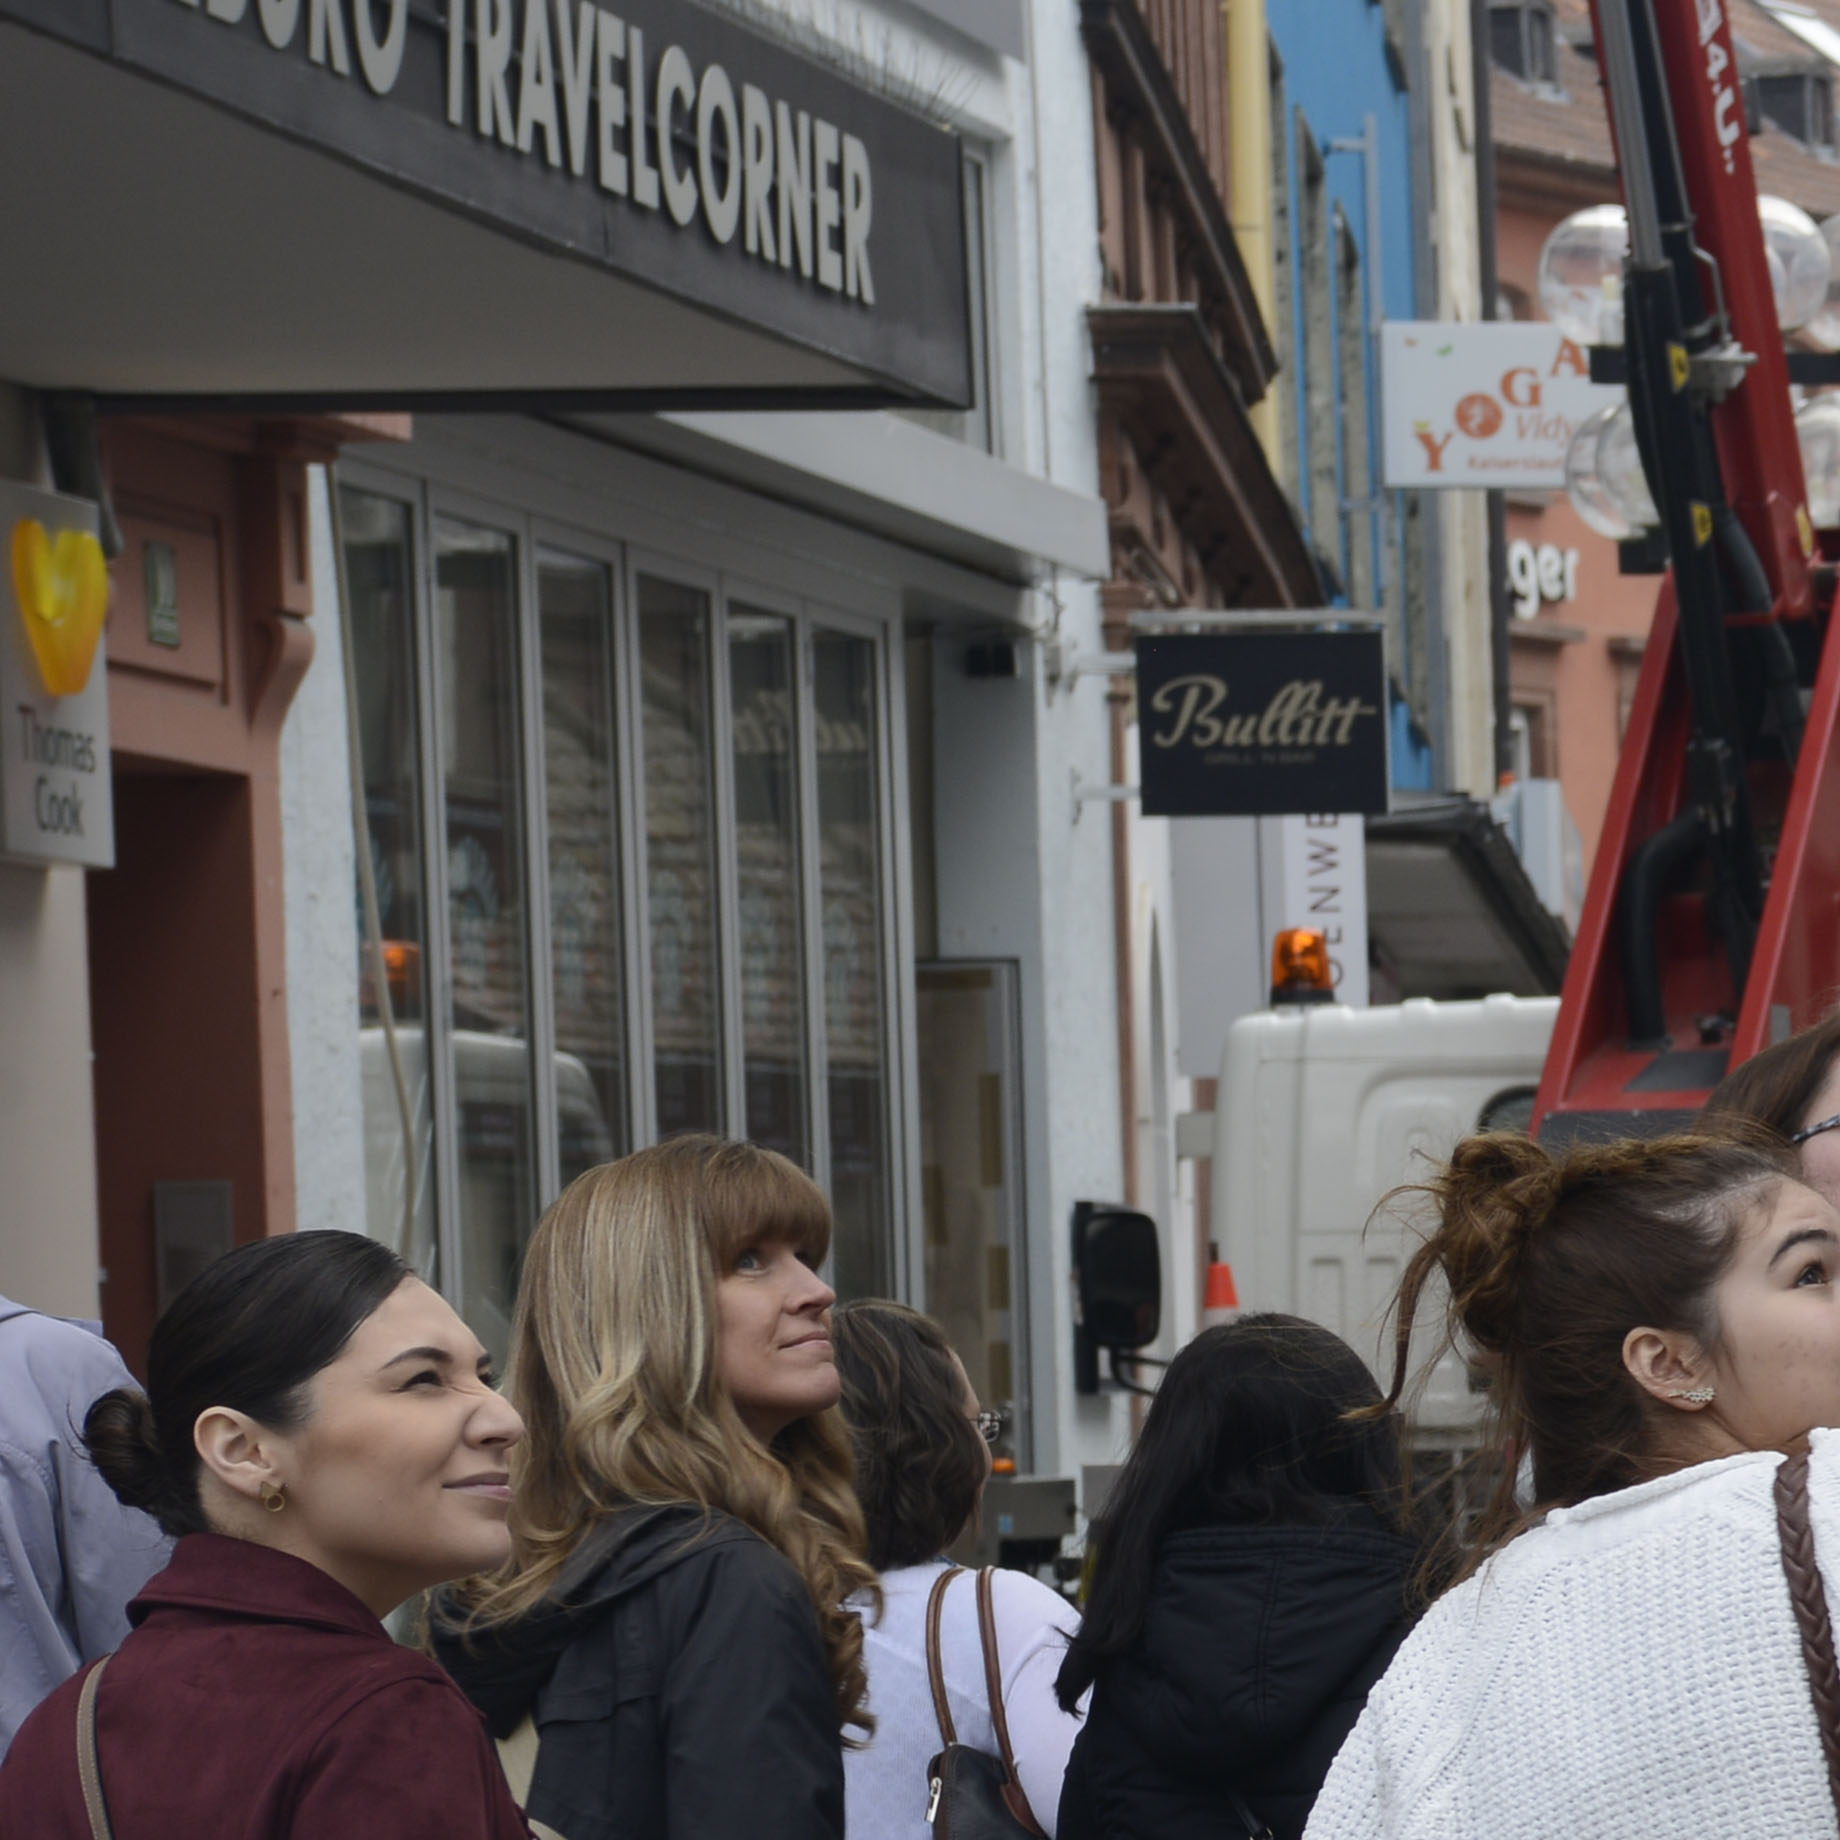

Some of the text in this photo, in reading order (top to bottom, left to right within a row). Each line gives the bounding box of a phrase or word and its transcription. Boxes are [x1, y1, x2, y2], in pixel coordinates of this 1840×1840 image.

[1507, 539, 1580, 621] ger
[16, 703, 97, 775] Thomas
[1152, 673, 1378, 749] Bullitt
[34, 775, 85, 837] Cook
